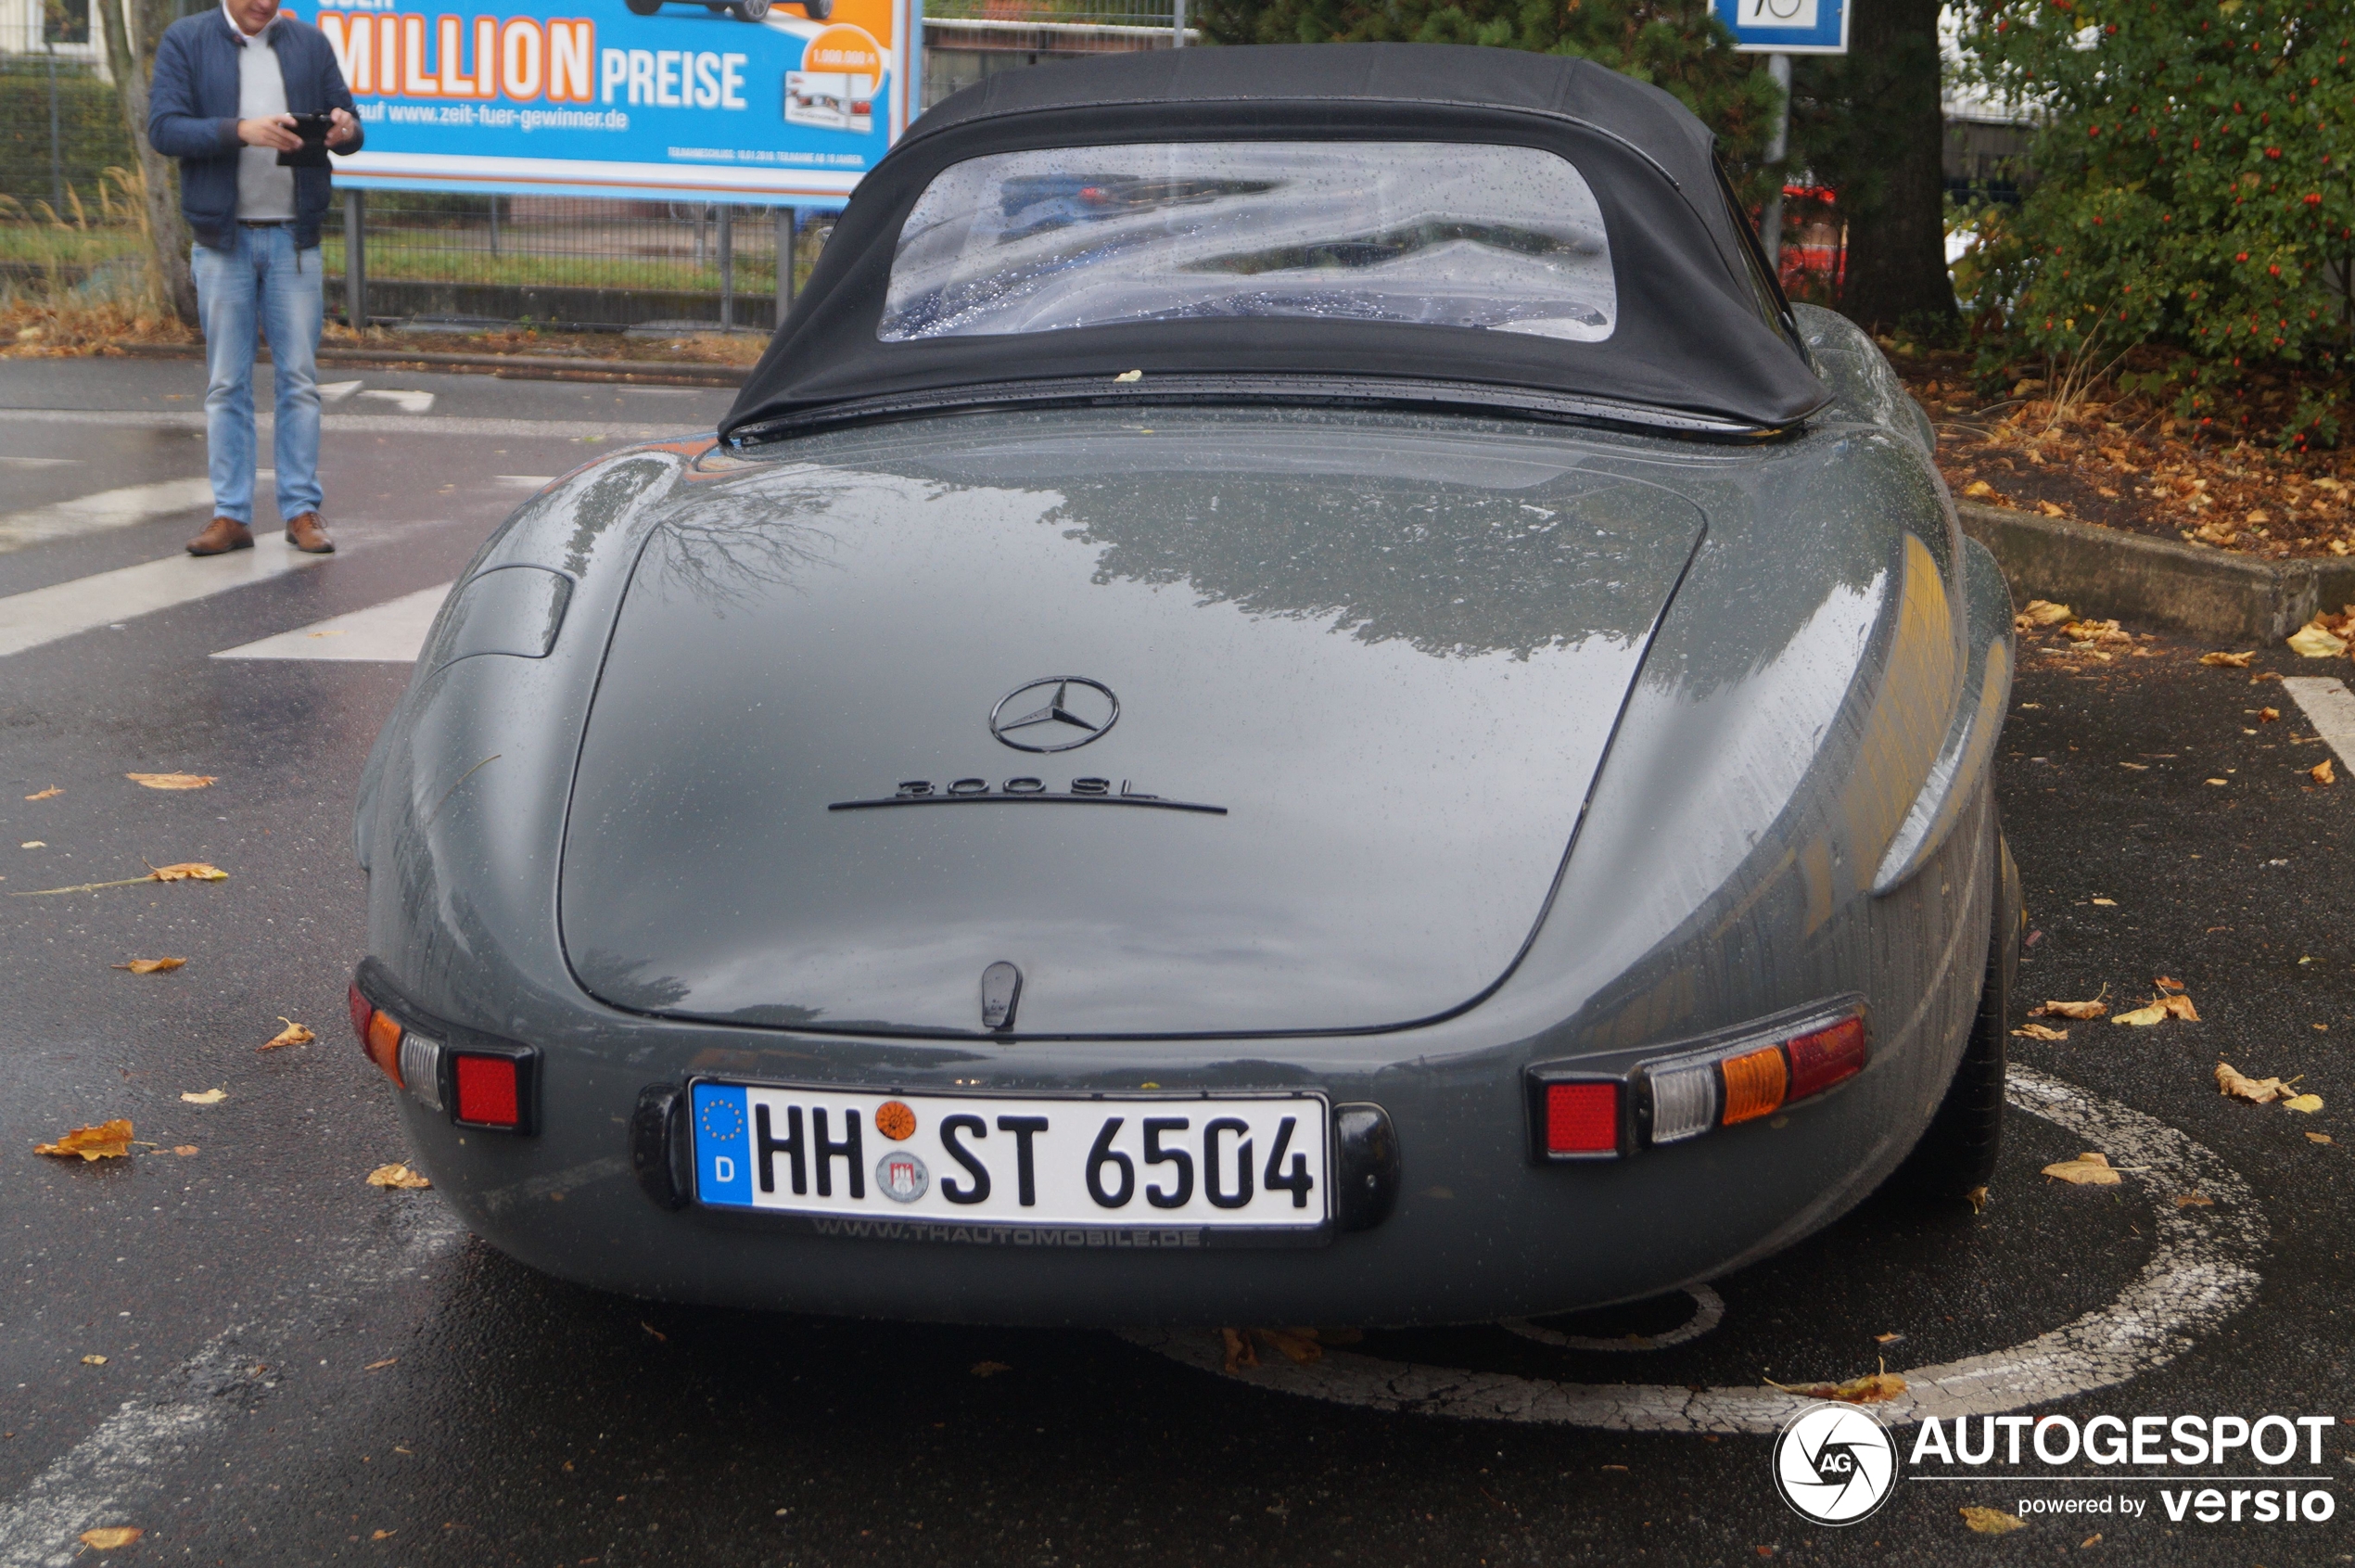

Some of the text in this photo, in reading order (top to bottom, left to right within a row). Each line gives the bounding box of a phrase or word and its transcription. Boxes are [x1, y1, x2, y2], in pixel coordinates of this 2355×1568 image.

[317, 11, 748, 108] MILLION PREISE
[813, 48, 865, 64] 1.000.000
[356, 101, 629, 132] auf www.zeit-fuer-gewinner.de
[896, 777, 1159, 799] 300 SL
[715, 1155, 735, 1183] D
[755, 1103, 1314, 1208] HH ST 6504
